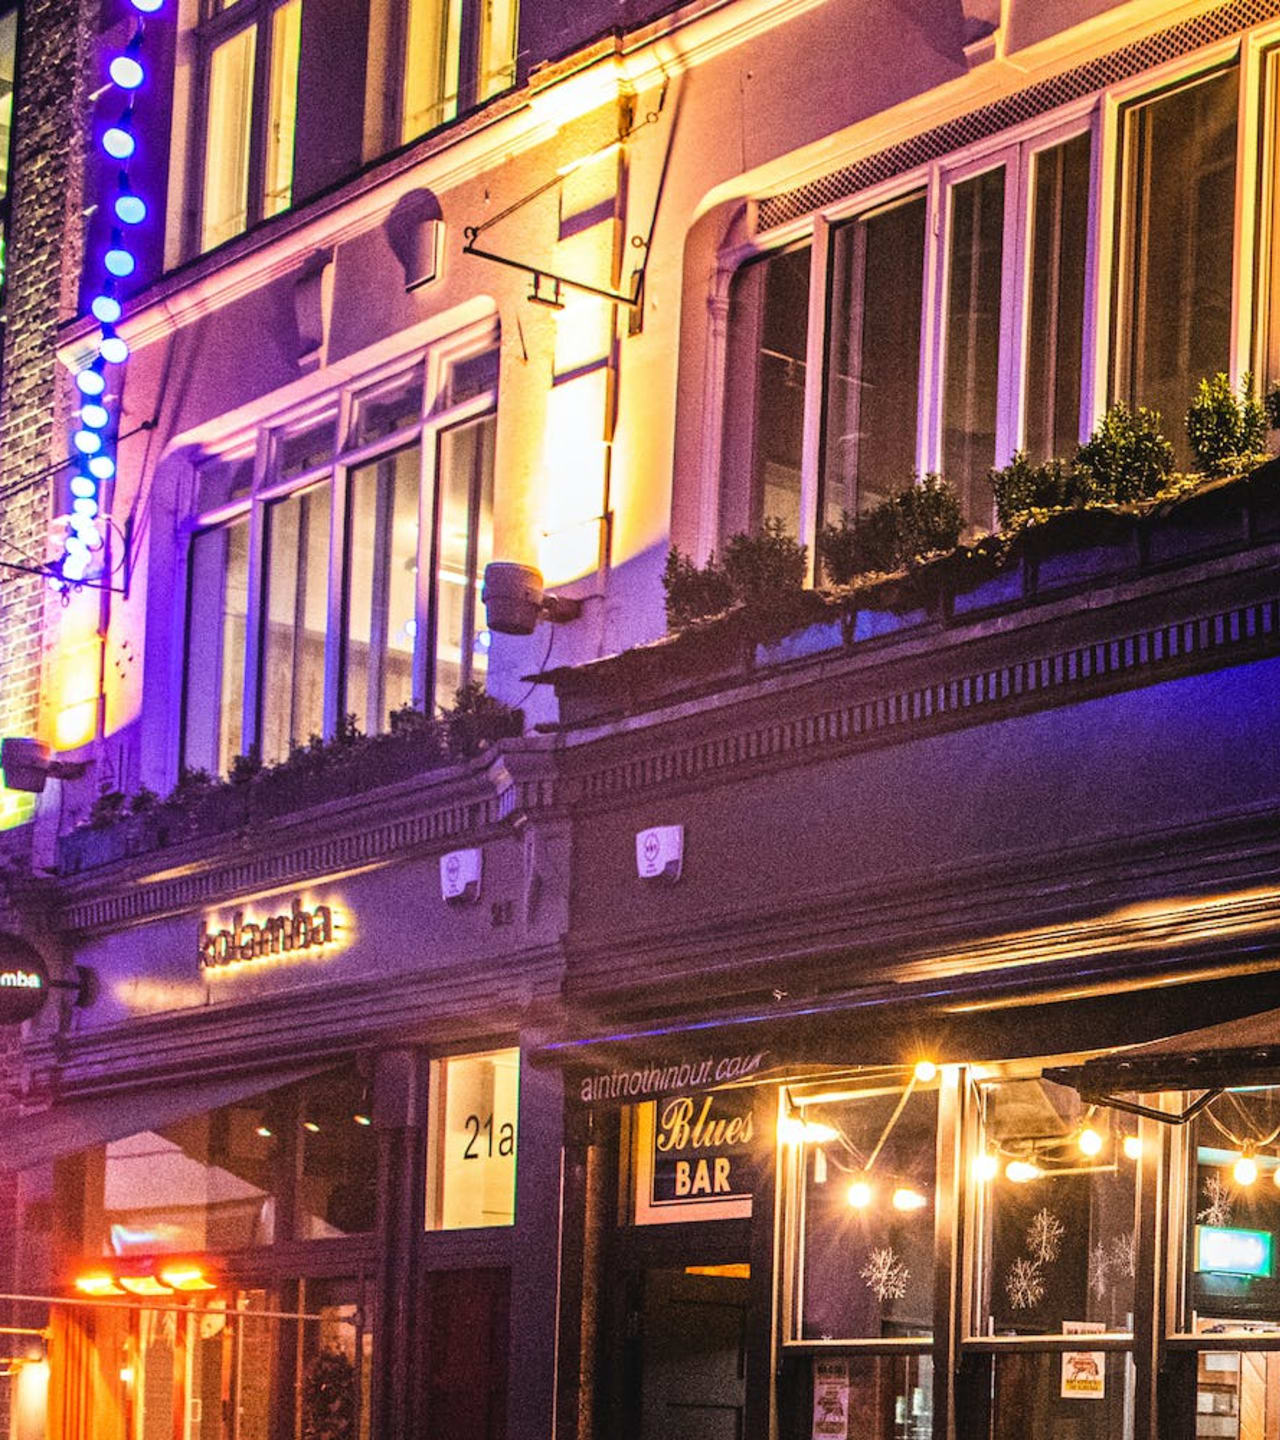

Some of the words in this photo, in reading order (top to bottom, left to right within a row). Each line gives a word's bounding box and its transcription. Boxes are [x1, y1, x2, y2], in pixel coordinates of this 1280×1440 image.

[198, 898, 332, 970] kolamba
[463, 1113, 514, 1160] 21a
[657, 1095, 753, 1151] Blues
[675, 1157, 732, 1196] BAR
